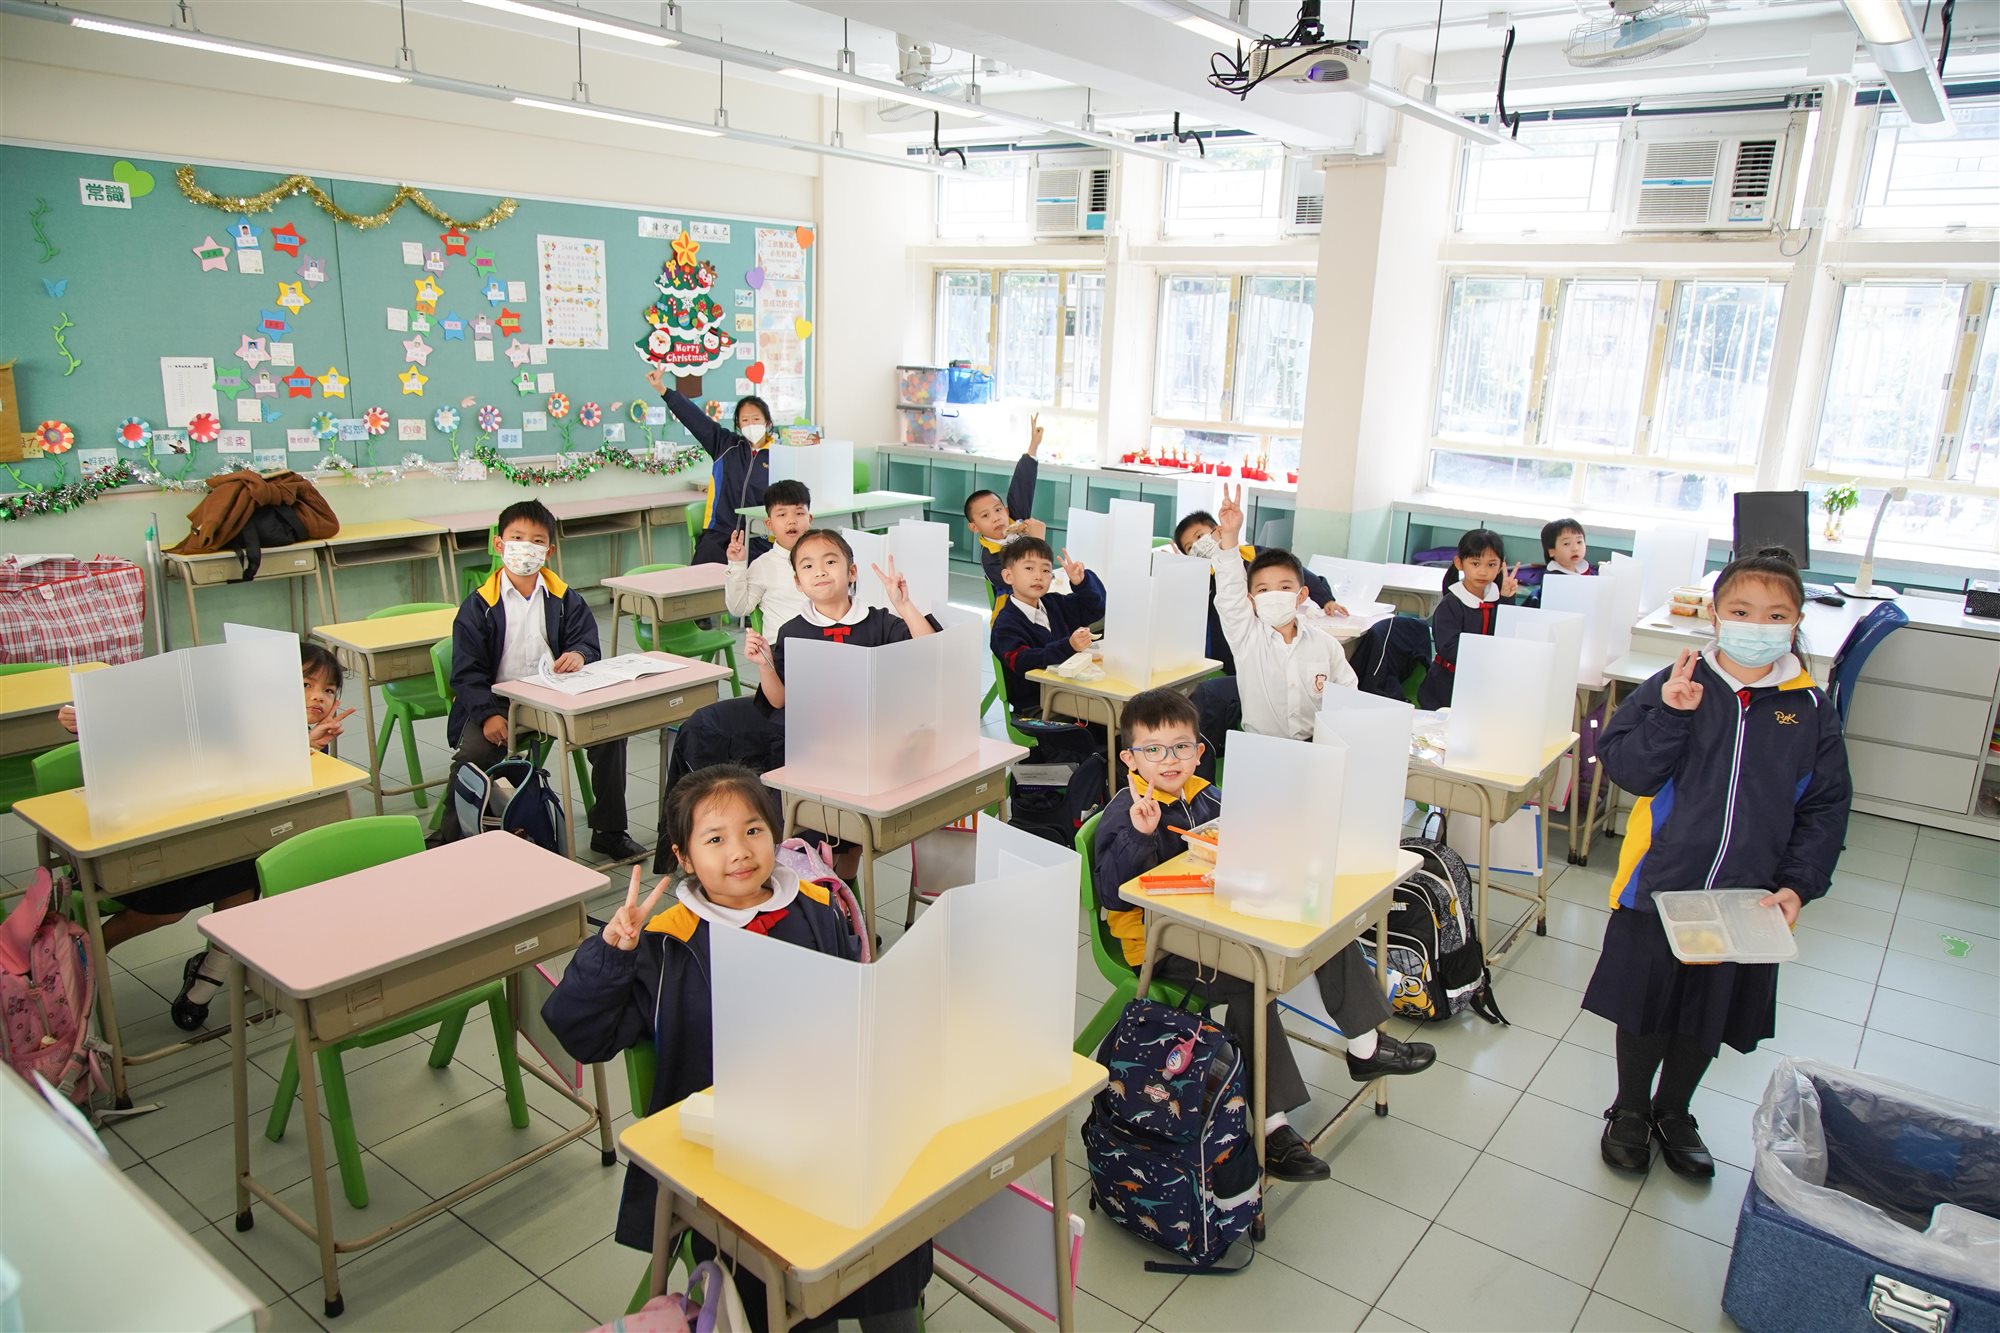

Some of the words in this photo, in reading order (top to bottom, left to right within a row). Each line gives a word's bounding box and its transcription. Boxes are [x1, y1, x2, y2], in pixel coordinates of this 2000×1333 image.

[86, 183, 125, 203] 常識
[675, 343, 701, 354] Merry
[666, 353, 709, 363] Christmas!
